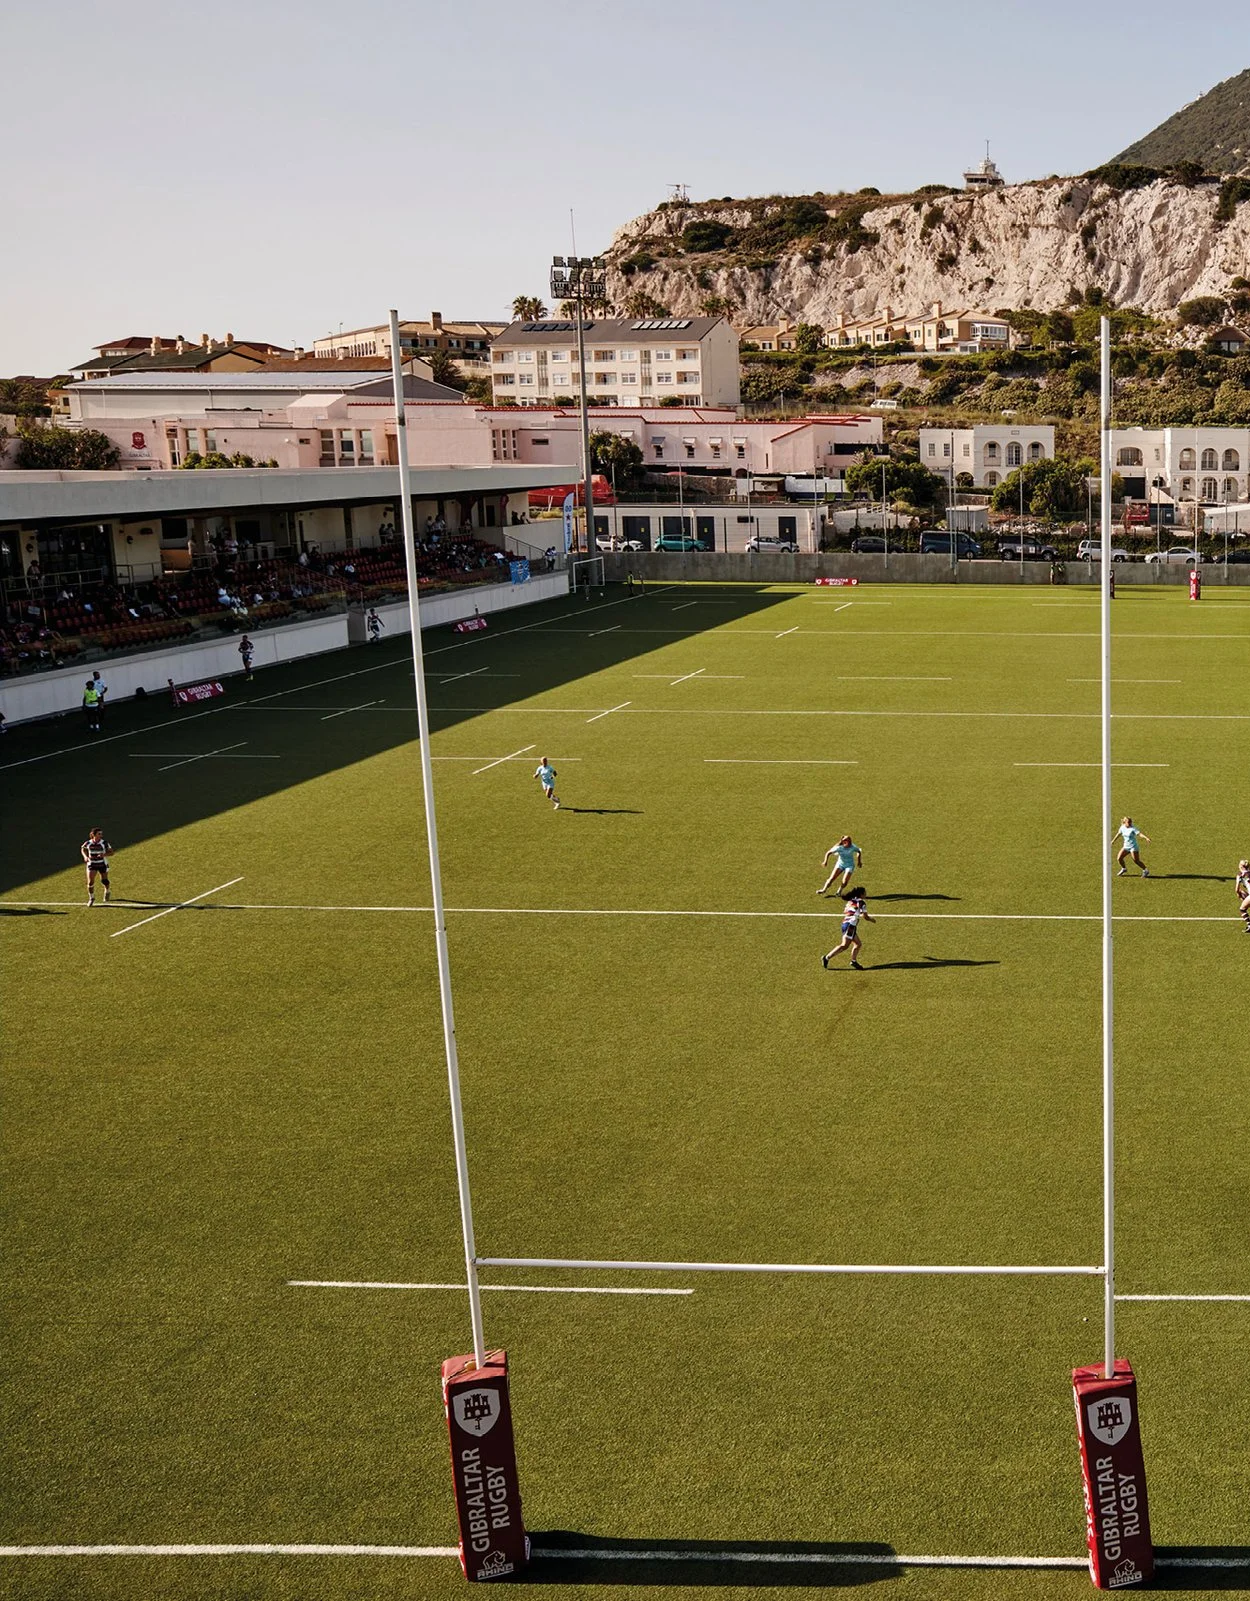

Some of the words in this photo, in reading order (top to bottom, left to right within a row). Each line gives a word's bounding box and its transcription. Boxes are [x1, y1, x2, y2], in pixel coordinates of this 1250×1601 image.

[461, 1447, 490, 1552] GIBRALTAR
[485, 1465, 511, 1529] RUGBY
[1096, 1455, 1122, 1561] GIBRALTAR
[1118, 1473, 1141, 1538] RUGBY
[476, 1563, 514, 1579] RHINO
[1108, 1570, 1143, 1586] RHINO
